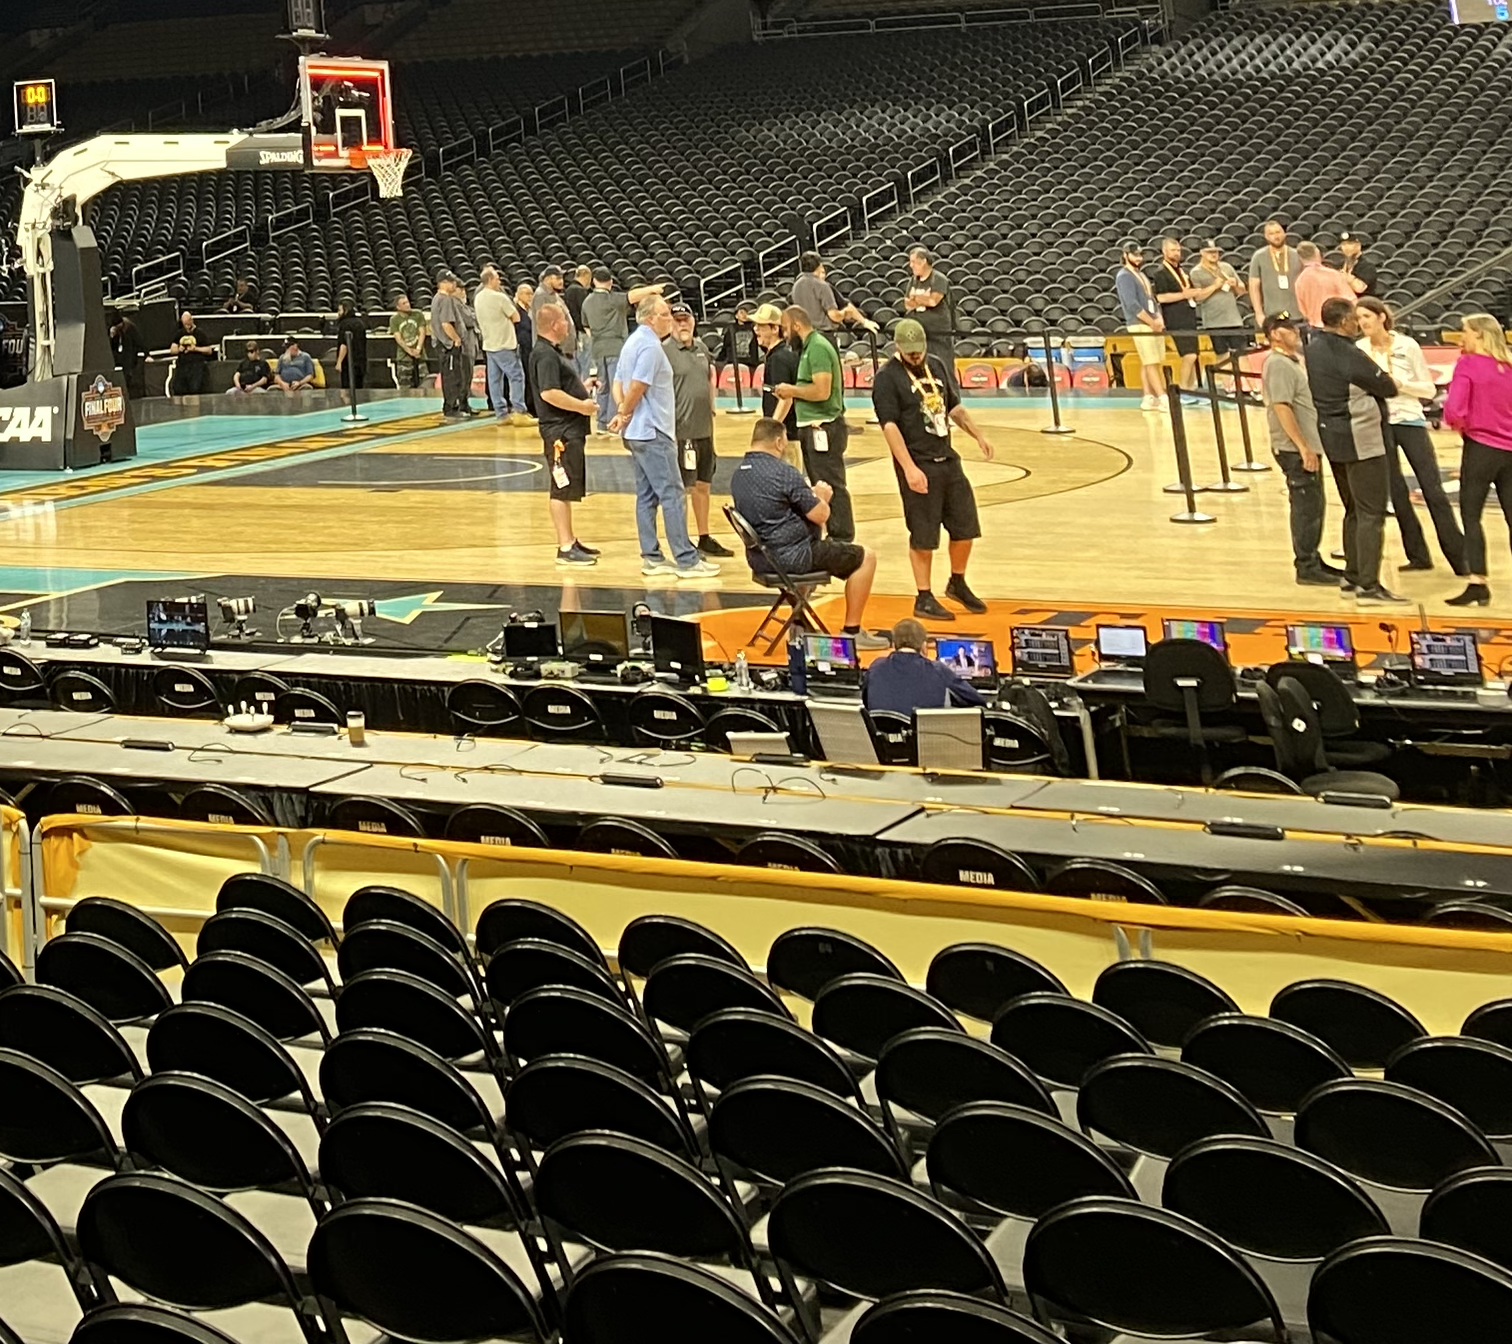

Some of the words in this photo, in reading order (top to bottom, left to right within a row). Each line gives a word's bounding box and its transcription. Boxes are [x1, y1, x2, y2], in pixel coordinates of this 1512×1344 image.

[259, 149, 304, 165] SPALDING
[2, 338, 24, 355] FOU
[76, 803, 101, 815] MEDIA
[357, 820, 387, 833] MEDIA
[958, 869, 995, 885] MEDIA
